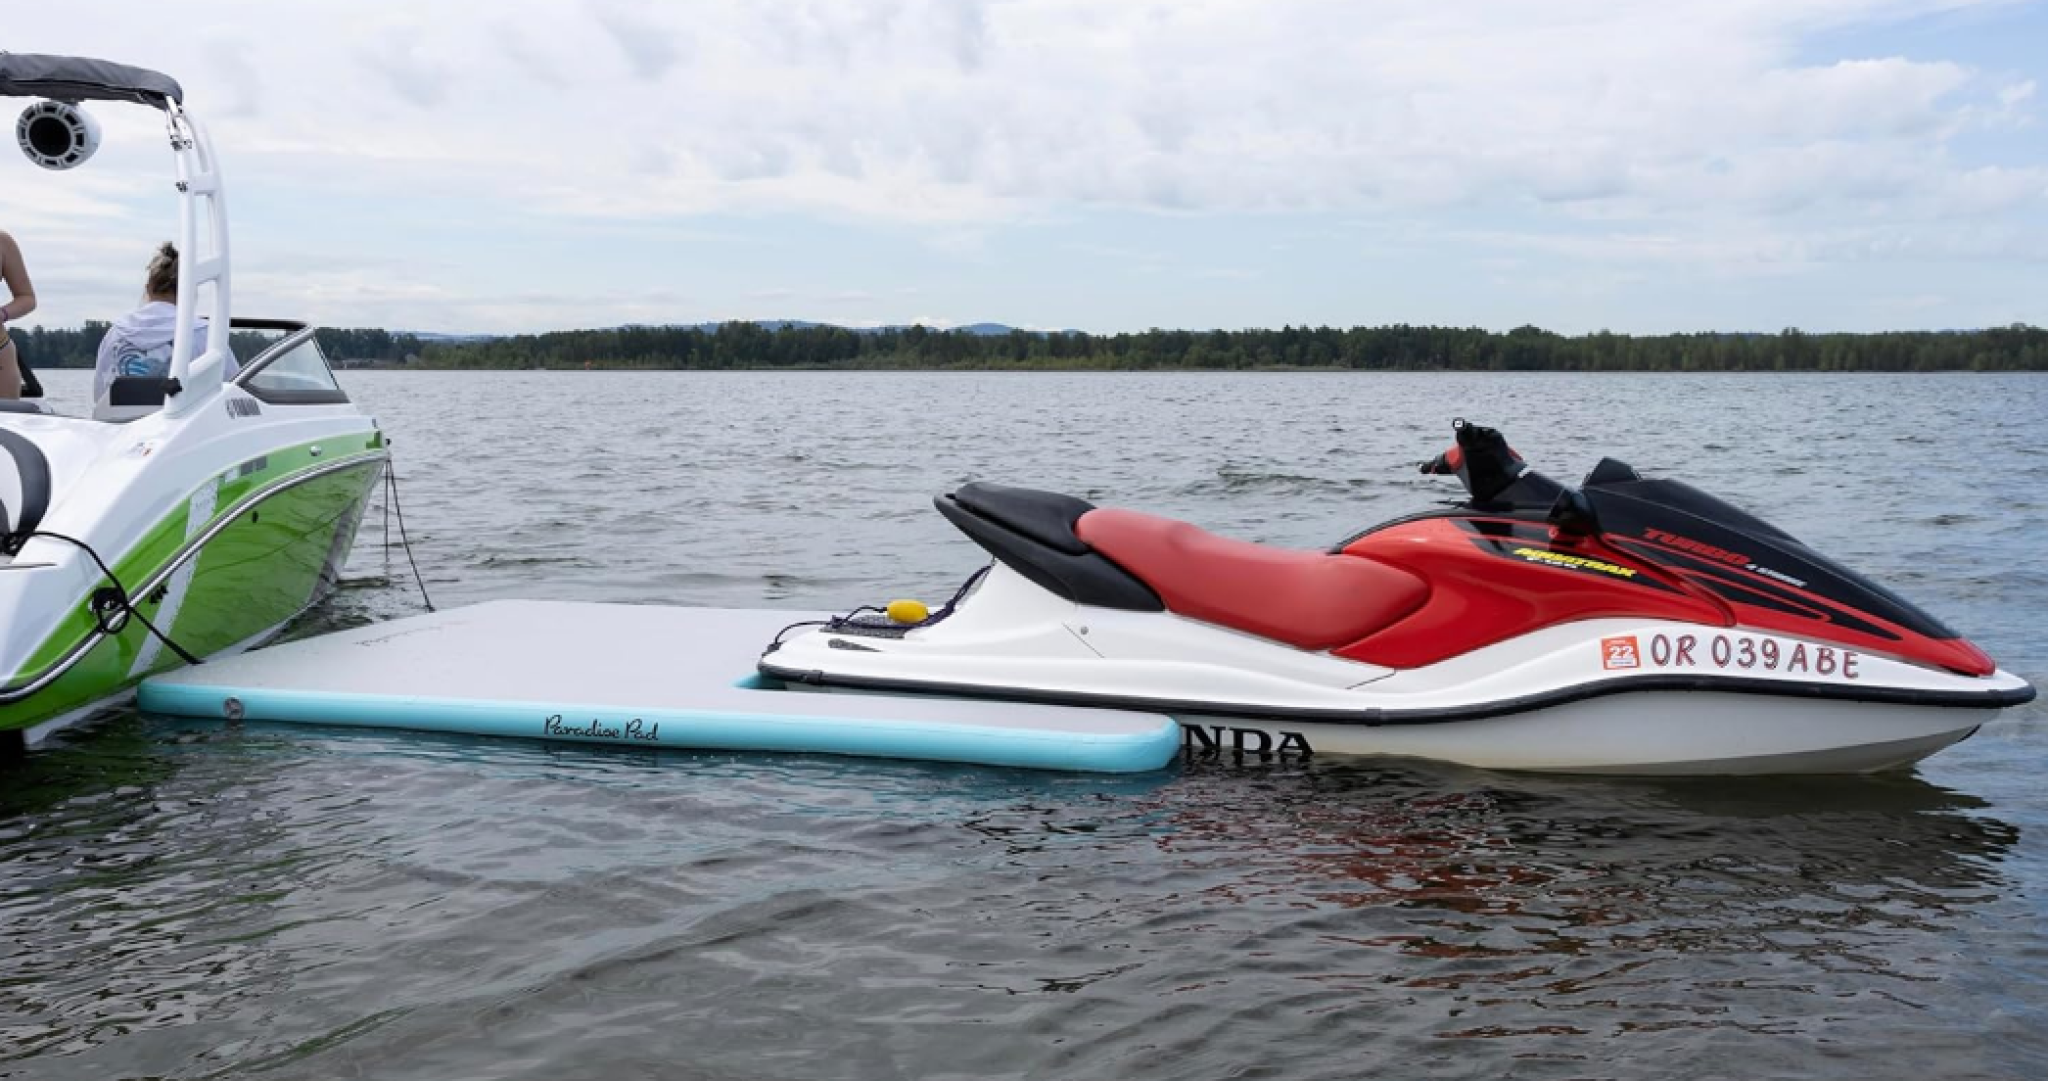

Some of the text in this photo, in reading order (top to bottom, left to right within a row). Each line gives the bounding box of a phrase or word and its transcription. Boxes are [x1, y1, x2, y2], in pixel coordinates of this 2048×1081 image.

[1651, 634, 1859, 679] OR 039 ABE
[544, 715, 658, 740] Paradise Pad
